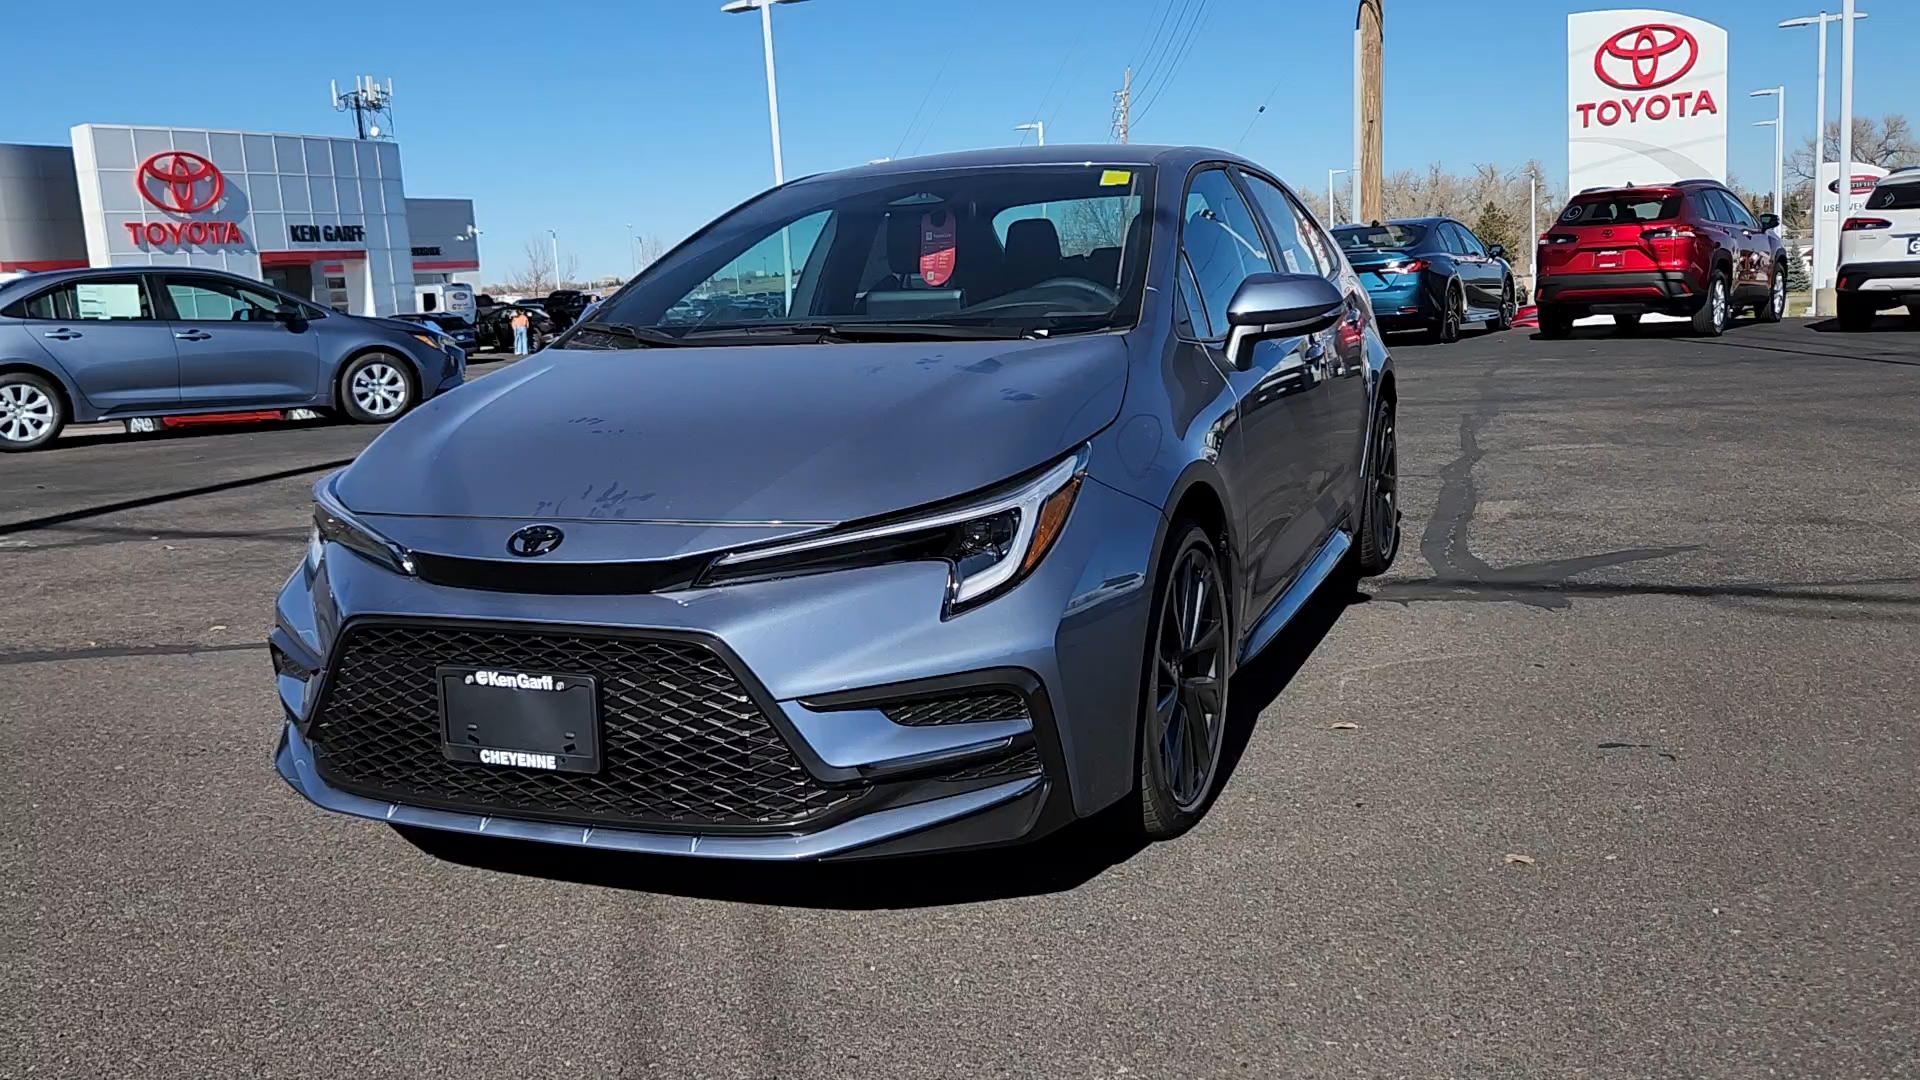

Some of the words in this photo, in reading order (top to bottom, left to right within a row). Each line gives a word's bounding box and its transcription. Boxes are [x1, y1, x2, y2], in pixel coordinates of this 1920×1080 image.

[1575, 90, 1717, 128] TOYOTA
[124, 221, 244, 246] TOYOTA
[290, 225, 321, 242] KEN
[322, 225, 367, 242] GARFF
[480, 749, 557, 770] CHEYENNE
